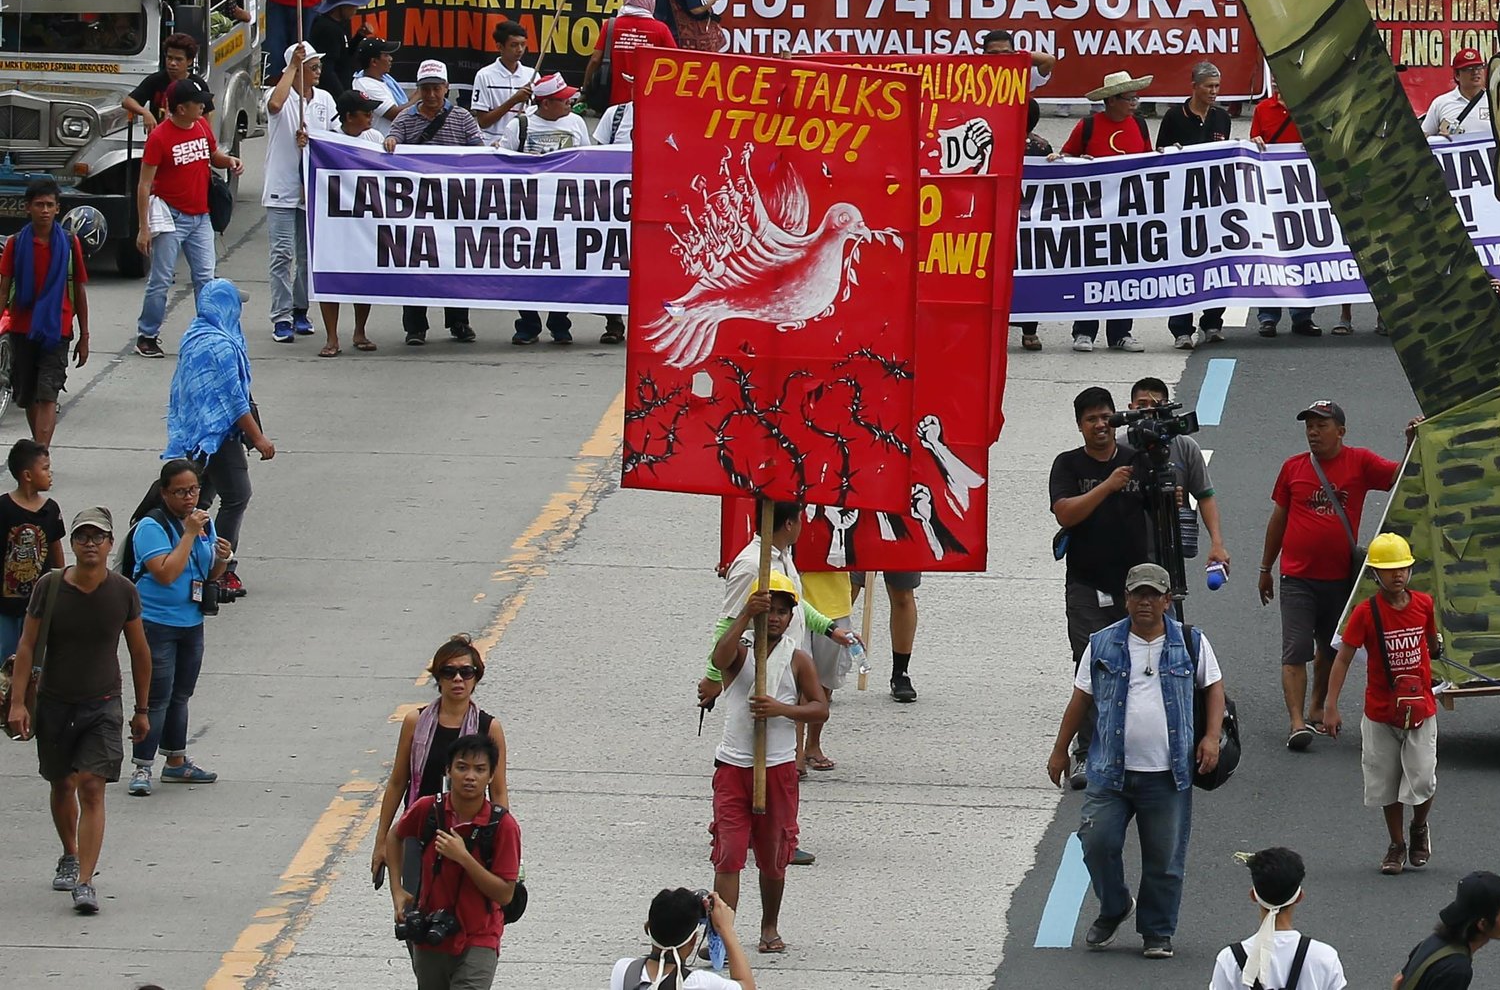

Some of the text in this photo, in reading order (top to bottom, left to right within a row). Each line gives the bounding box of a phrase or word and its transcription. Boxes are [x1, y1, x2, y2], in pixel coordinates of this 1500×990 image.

[1075, 27, 1240, 56] WAKASAN!
[643, 57, 907, 122] PEACE TALKS
[172, 137, 210, 158] SERVE
[173, 150, 211, 167] PEOPLE
[704, 109, 871, 163] ITULOY!
[327, 174, 632, 221] LABANAN ANG
[1118, 171, 1171, 216] AT
[376, 225, 562, 271] NA MGA
[1084, 258, 1361, 305] BAGONG ALYANSANG
[1385, 635, 1421, 650] NMW
